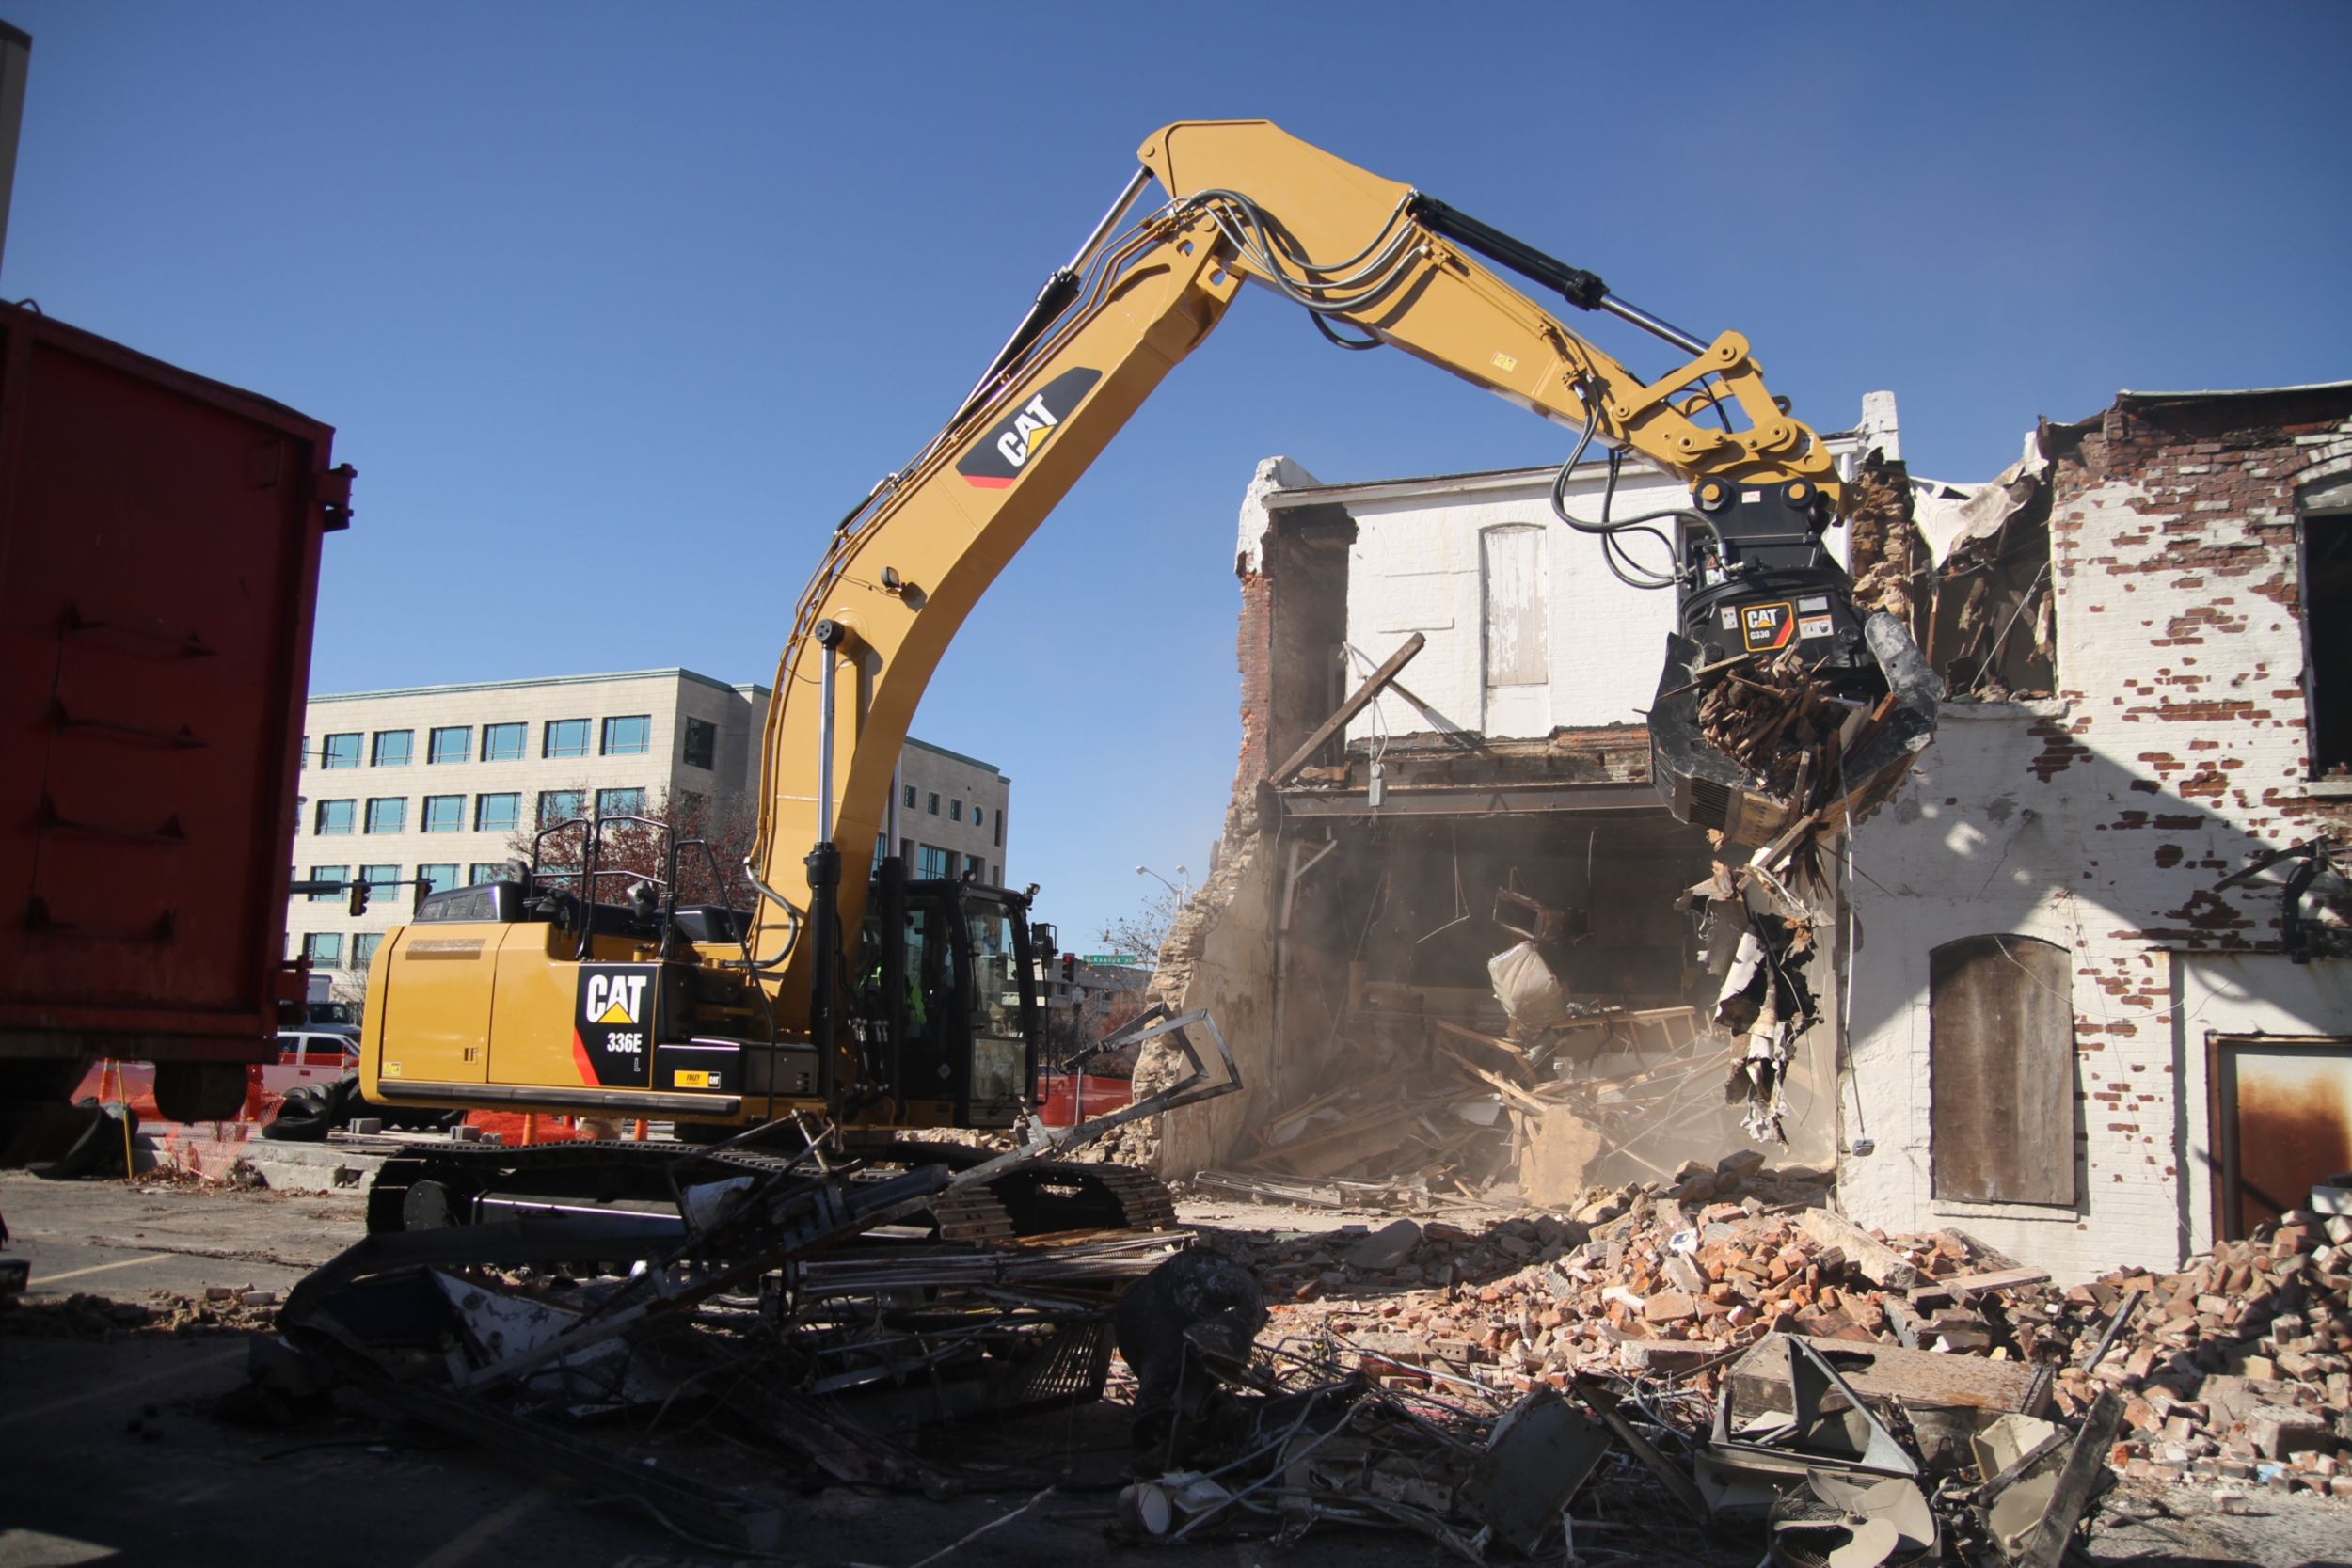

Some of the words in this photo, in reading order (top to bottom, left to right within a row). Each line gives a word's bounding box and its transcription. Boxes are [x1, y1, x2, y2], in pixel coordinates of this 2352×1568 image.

[997, 393, 1058, 467] CAT
[1747, 608, 1777, 628] CAT
[586, 974, 647, 1024] CAT
[607, 1032, 642, 1053] 336E
[633, 1057, 641, 1071] L
